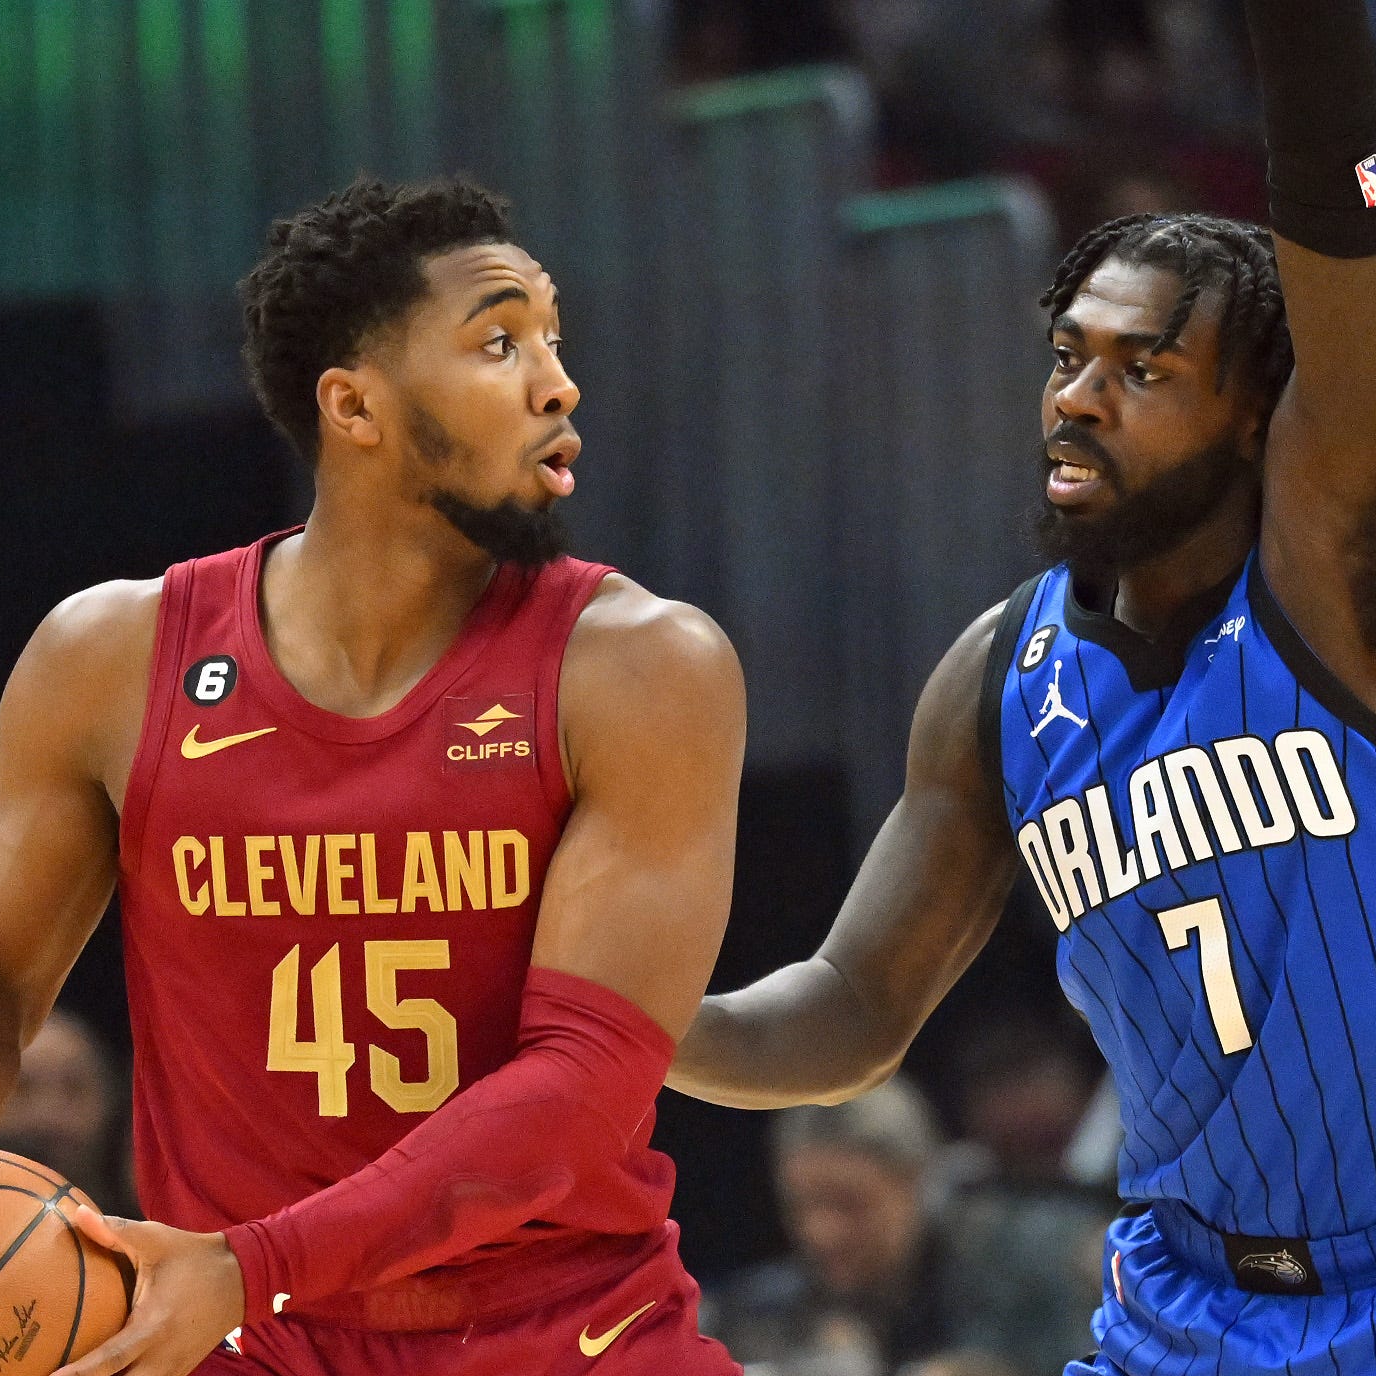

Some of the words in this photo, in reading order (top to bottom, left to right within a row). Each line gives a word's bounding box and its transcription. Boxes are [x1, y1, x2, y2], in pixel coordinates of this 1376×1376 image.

[194, 662, 228, 701] 6
[1022, 627, 1052, 669] 6
[446, 740, 531, 762] CLIFFS
[171, 829, 531, 918] CLEVELAND
[1016, 728, 1358, 934] ORLANDO
[1153, 896, 1256, 1057] 7
[265, 938, 461, 1118] 45
